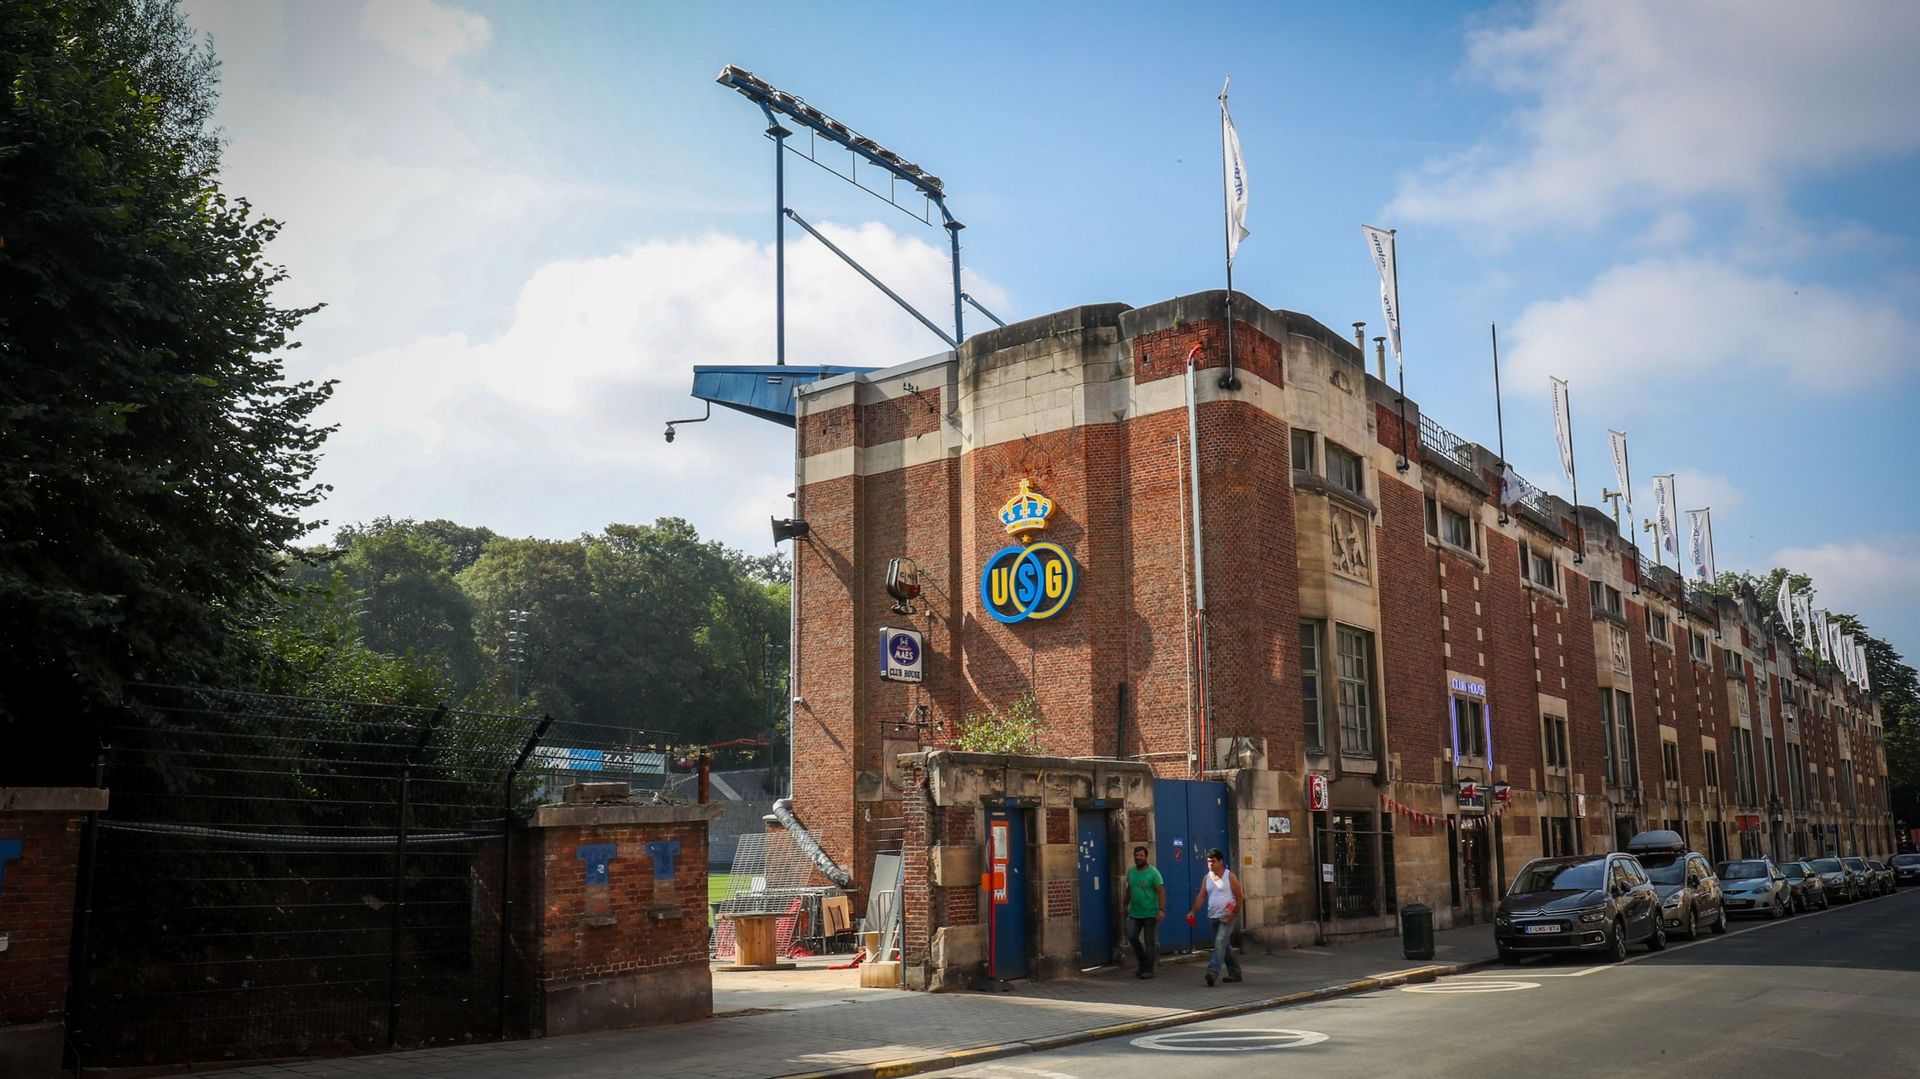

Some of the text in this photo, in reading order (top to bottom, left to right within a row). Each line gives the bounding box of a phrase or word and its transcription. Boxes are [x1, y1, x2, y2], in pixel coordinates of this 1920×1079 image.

[992, 559, 1062, 606] USG
[895, 651, 913, 660] MAES
[889, 668, 921, 679] CLUB HOUSE
[1452, 678, 1486, 696] CLUB HOUSE
[603, 753, 633, 763] ZAZ
